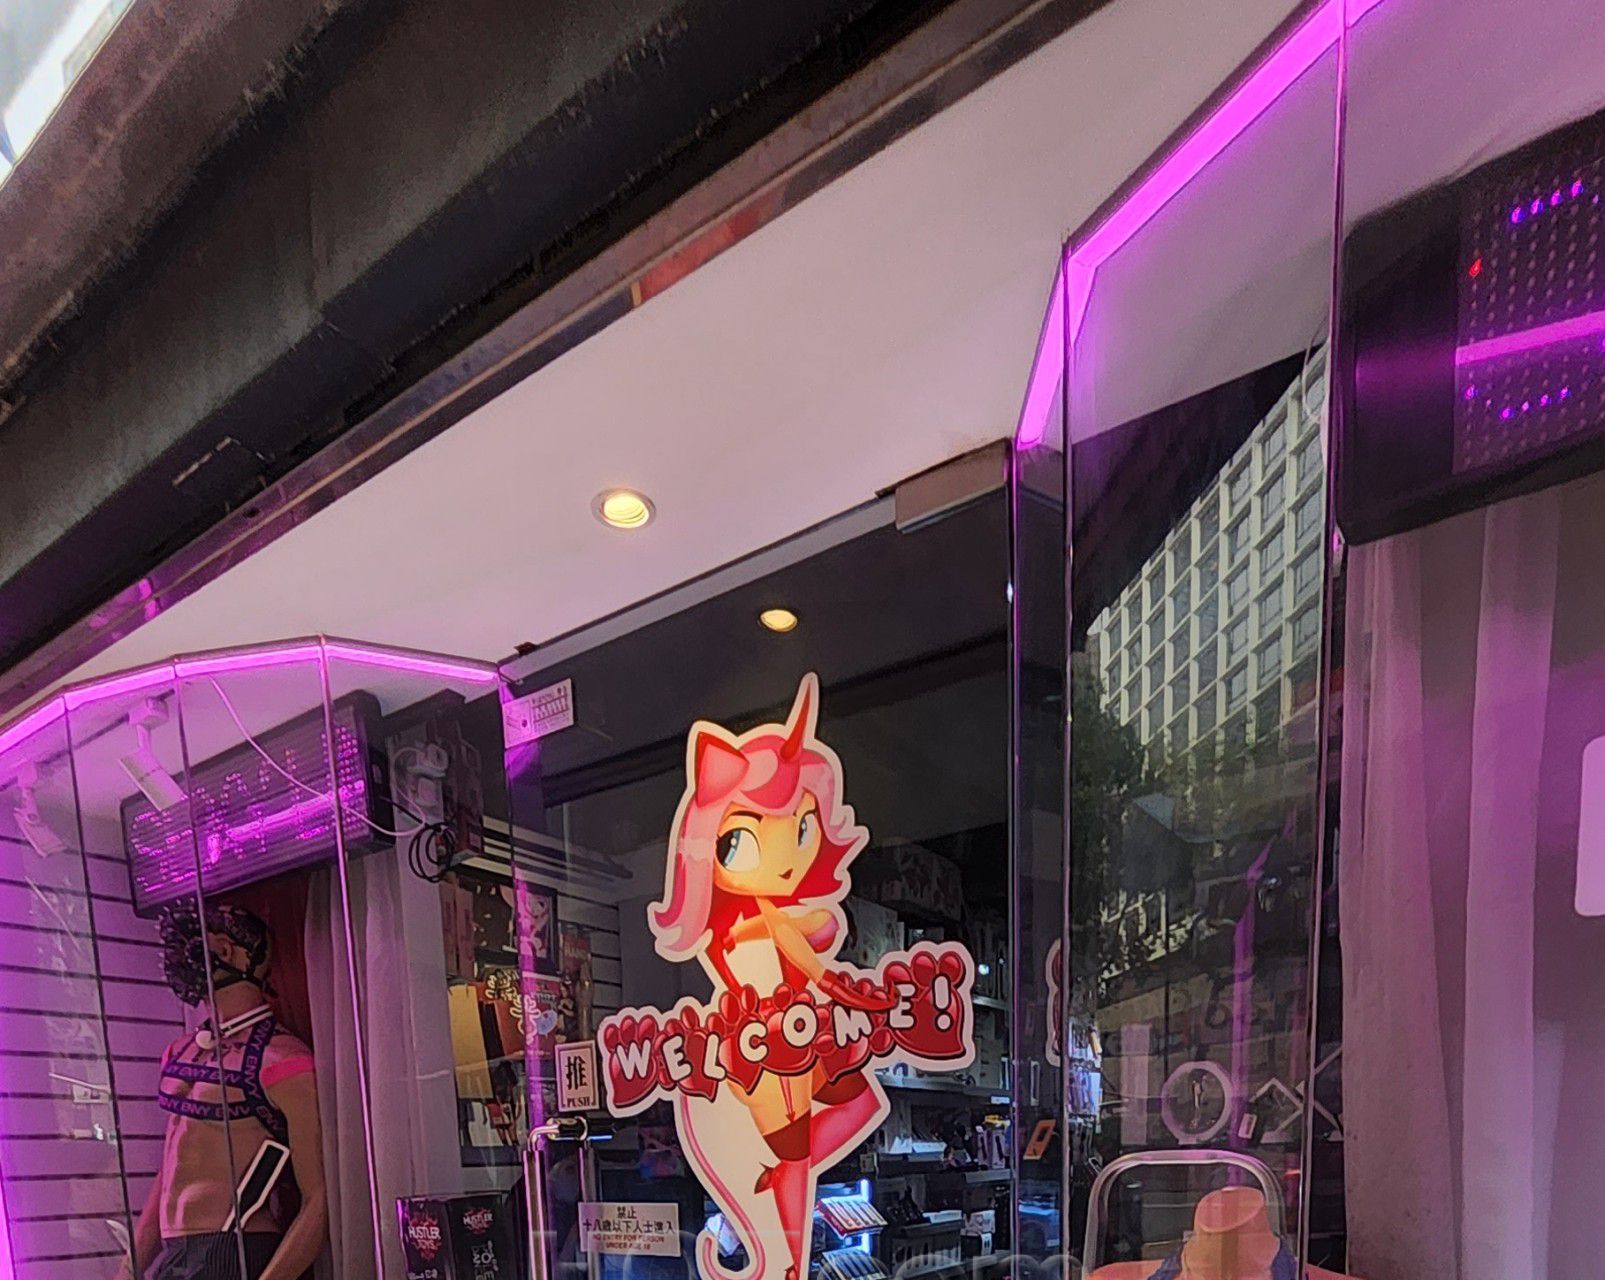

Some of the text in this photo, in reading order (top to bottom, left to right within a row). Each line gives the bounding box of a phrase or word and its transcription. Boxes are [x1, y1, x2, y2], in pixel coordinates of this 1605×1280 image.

[613, 974, 953, 1083] WELCOME!
[244, 1055, 262, 1100] ENVY
[565, 1056, 588, 1090] 推
[566, 1096, 592, 1108] PUSH
[616, 1205, 638, 1219] 禁止
[408, 1225, 442, 1241] HUSTLER
[623, 1234, 637, 1242] FOR
[605, 1241, 628, 1249] UNDER
